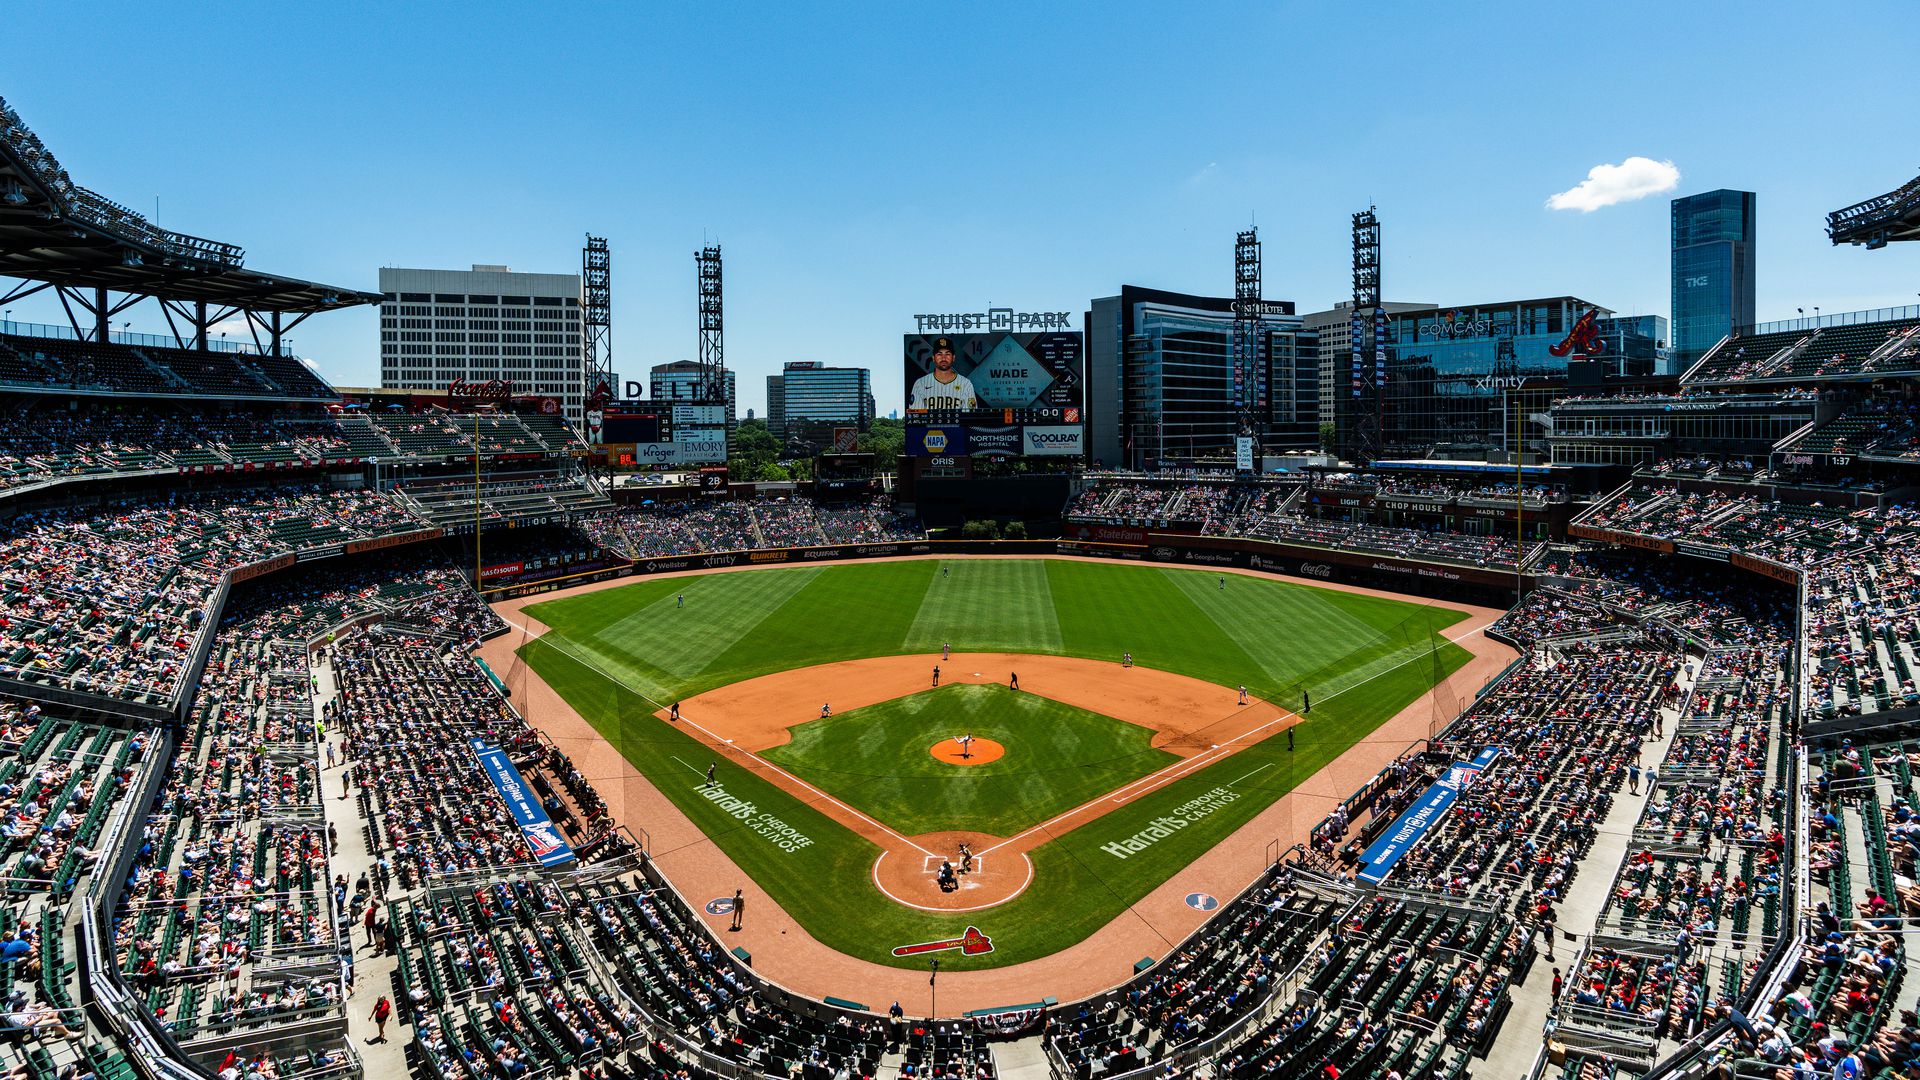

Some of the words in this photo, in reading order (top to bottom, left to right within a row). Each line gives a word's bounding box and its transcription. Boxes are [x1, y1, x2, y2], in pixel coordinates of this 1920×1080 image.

[1685, 276, 1708, 287] TKE
[914, 314, 984, 329] TRUIST
[1018, 312, 1070, 328] PARK
[1420, 320, 1492, 336] COMCAST
[990, 369, 1028, 378] WADE
[1476, 375, 1526, 390] xfinity
[626, 381, 723, 398] DELTA
[928, 436, 945, 447] NAPA
[1031, 434, 1079, 442] COOLRAY
[644, 444, 675, 462] Kroger
[685, 442, 723, 452] EMORY
[368, 456, 377, 464] 42
[1832, 457, 1850, 465] 1:37
[708, 477, 720, 485] 2B
[1385, 501, 1409, 510] CHOP
[1412, 503, 1443, 512] HOUSE
[399, 533, 420, 544] SPORT
[1615, 535, 1642, 546] SPORT
[704, 556, 736, 567] xfinity
[750, 551, 788, 560] QUIKRETE
[500, 566, 518, 574] SOUTH
[1300, 562, 1332, 577] Coca-Cola
[1772, 568, 1794, 582] SPORT
[1436, 767, 1463, 791] Braves
[1173, 787, 1228, 815] CHEROKEE
[758, 813, 814, 847] CHEROKEE
[1100, 817, 1188, 859] Harrah's
[1186, 792, 1240, 820] CASINOS
[1392, 825, 1417, 843] TRUIST
[1416, 806, 1435, 820] PARK
[522, 821, 564, 846] Braves
[744, 818, 800, 852] CASINOS
